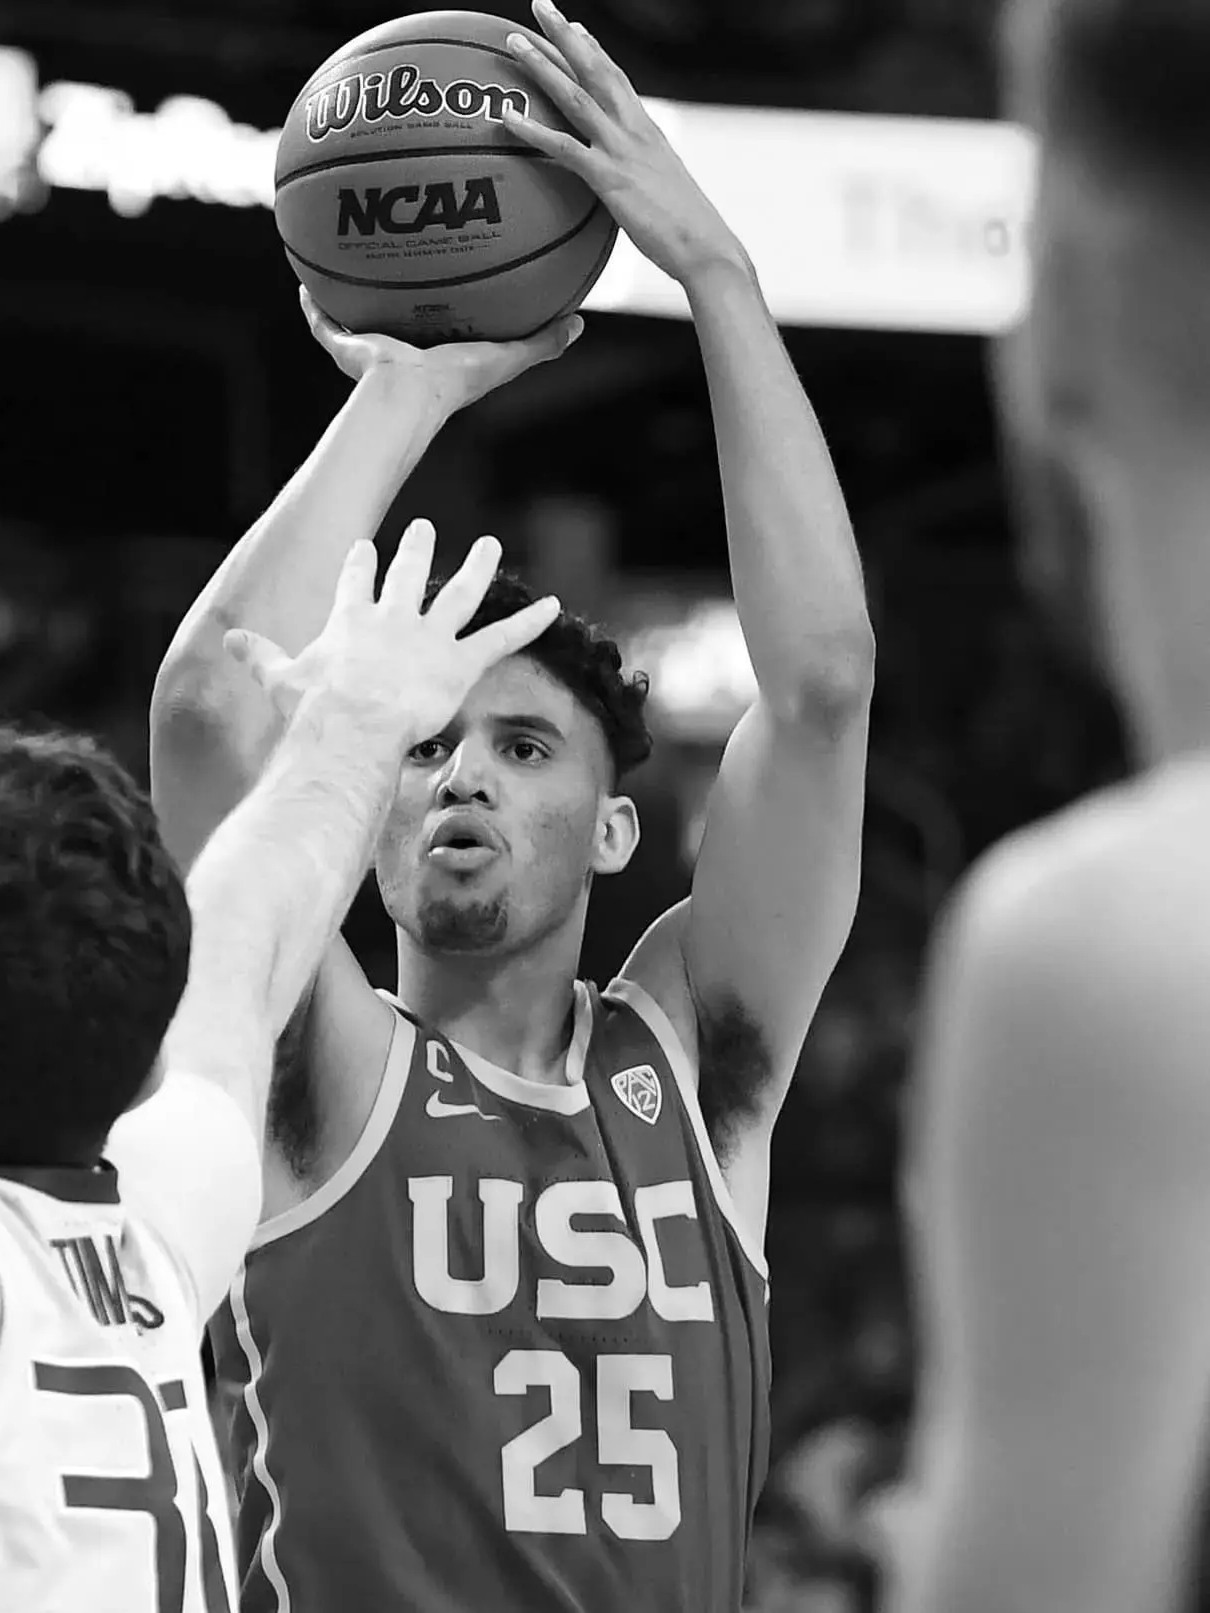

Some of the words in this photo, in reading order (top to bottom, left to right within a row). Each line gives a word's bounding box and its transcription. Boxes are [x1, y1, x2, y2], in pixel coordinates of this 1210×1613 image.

[305, 64, 530, 143] Wilson
[336, 176, 502, 237] NCAA
[407, 1175, 716, 1323] USC
[493, 1349, 683, 1541] 25
